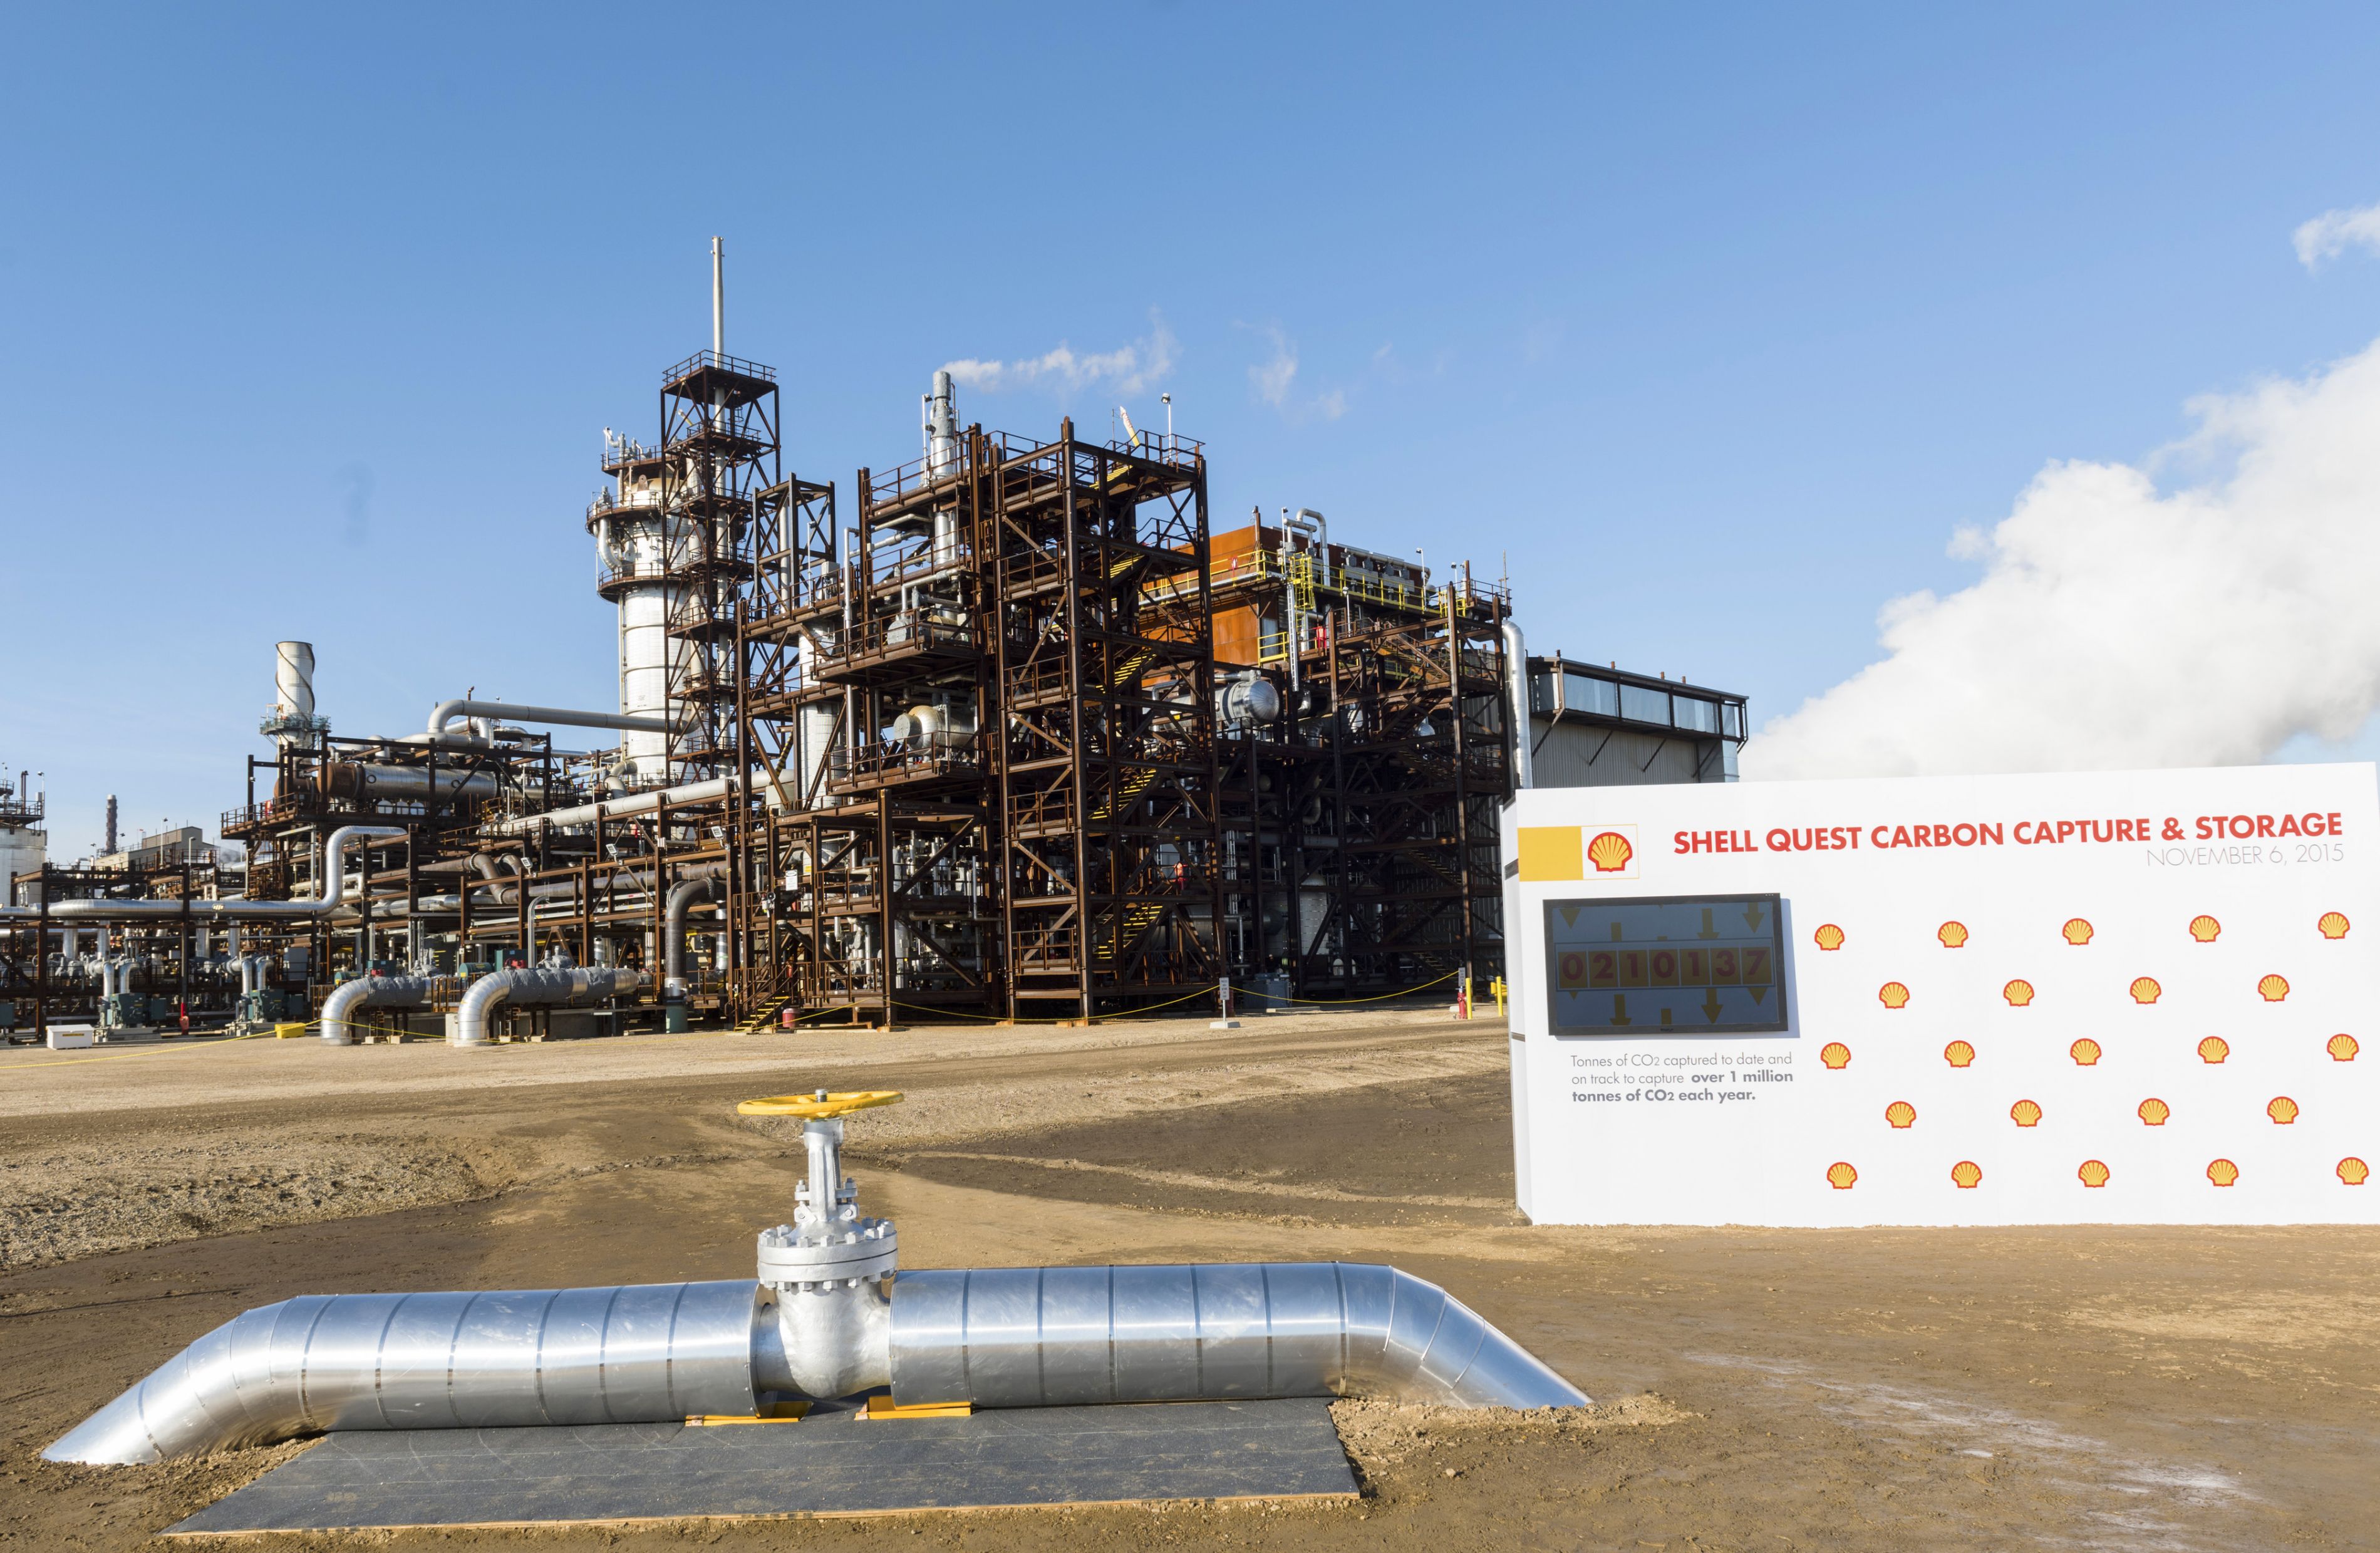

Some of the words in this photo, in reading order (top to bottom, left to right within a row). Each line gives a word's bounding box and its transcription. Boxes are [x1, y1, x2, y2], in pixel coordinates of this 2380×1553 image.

[1674, 830, 1759, 854] SHELL
[1766, 827, 1863, 852] QUEST
[1871, 823, 2004, 849] CARBON
[2014, 819, 2151, 845] CAPTURE
[2161, 817, 2185, 841] &
[2196, 813, 2342, 840] STORAGE
[2147, 846, 2263, 866] NOVEMBER
[2269, 846, 2287, 866] 6,
[2295, 844, 2344, 862] 2015
[1570, 1055, 1613, 1067] Tonnes
[1615, 1053, 1628, 1066] of
[1631, 1054, 1660, 1066] CO2
[1663, 1052, 1717, 1069] captured
[1721, 1054, 1733, 1065] to
[1736, 1052, 1764, 1065] date
[1767, 1051, 1792, 1064] and
[1571, 1076, 1587, 1084] on
[1590, 1071, 1620, 1084] track
[1623, 1074, 1635, 1084] to
[1638, 1073, 1684, 1087] capture
[1691, 1074, 1725, 1083] over
[1730, 1071, 1736, 1083] 1
[1743, 1069, 1793, 1083] million
[1572, 1091, 1622, 1102] tonnes
[1625, 1088, 1642, 1101] of
[1645, 1089, 1675, 1101] CO2
[1678, 1088, 1714, 1101] each
[1717, 1091, 1756, 1104] year.
